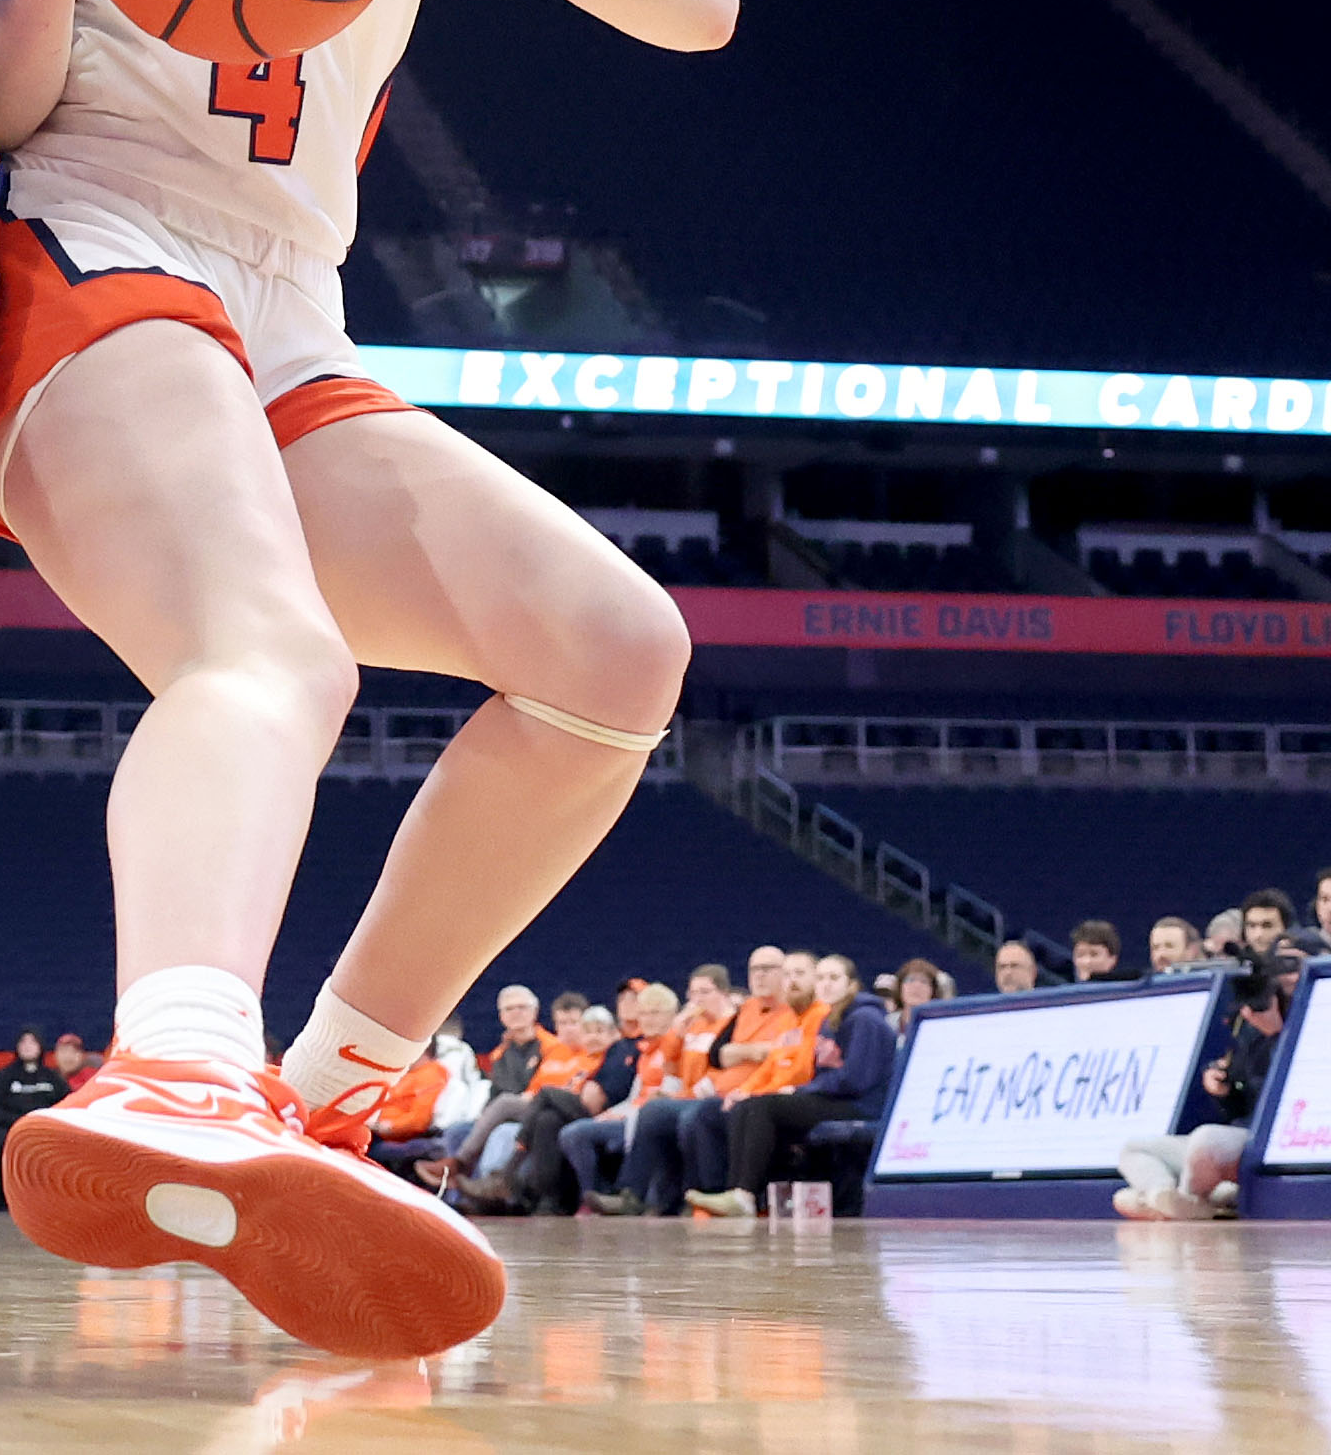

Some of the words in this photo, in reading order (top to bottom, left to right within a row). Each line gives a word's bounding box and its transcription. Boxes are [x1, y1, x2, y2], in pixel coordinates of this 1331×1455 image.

[207, 58, 307, 167] 4
[457, 349, 1053, 425] EXCEPTIONAL
[803, 604, 922, 637] ERNIE
[938, 606, 1054, 641] DAVIS
[1164, 610, 1287, 645] FLOYD
